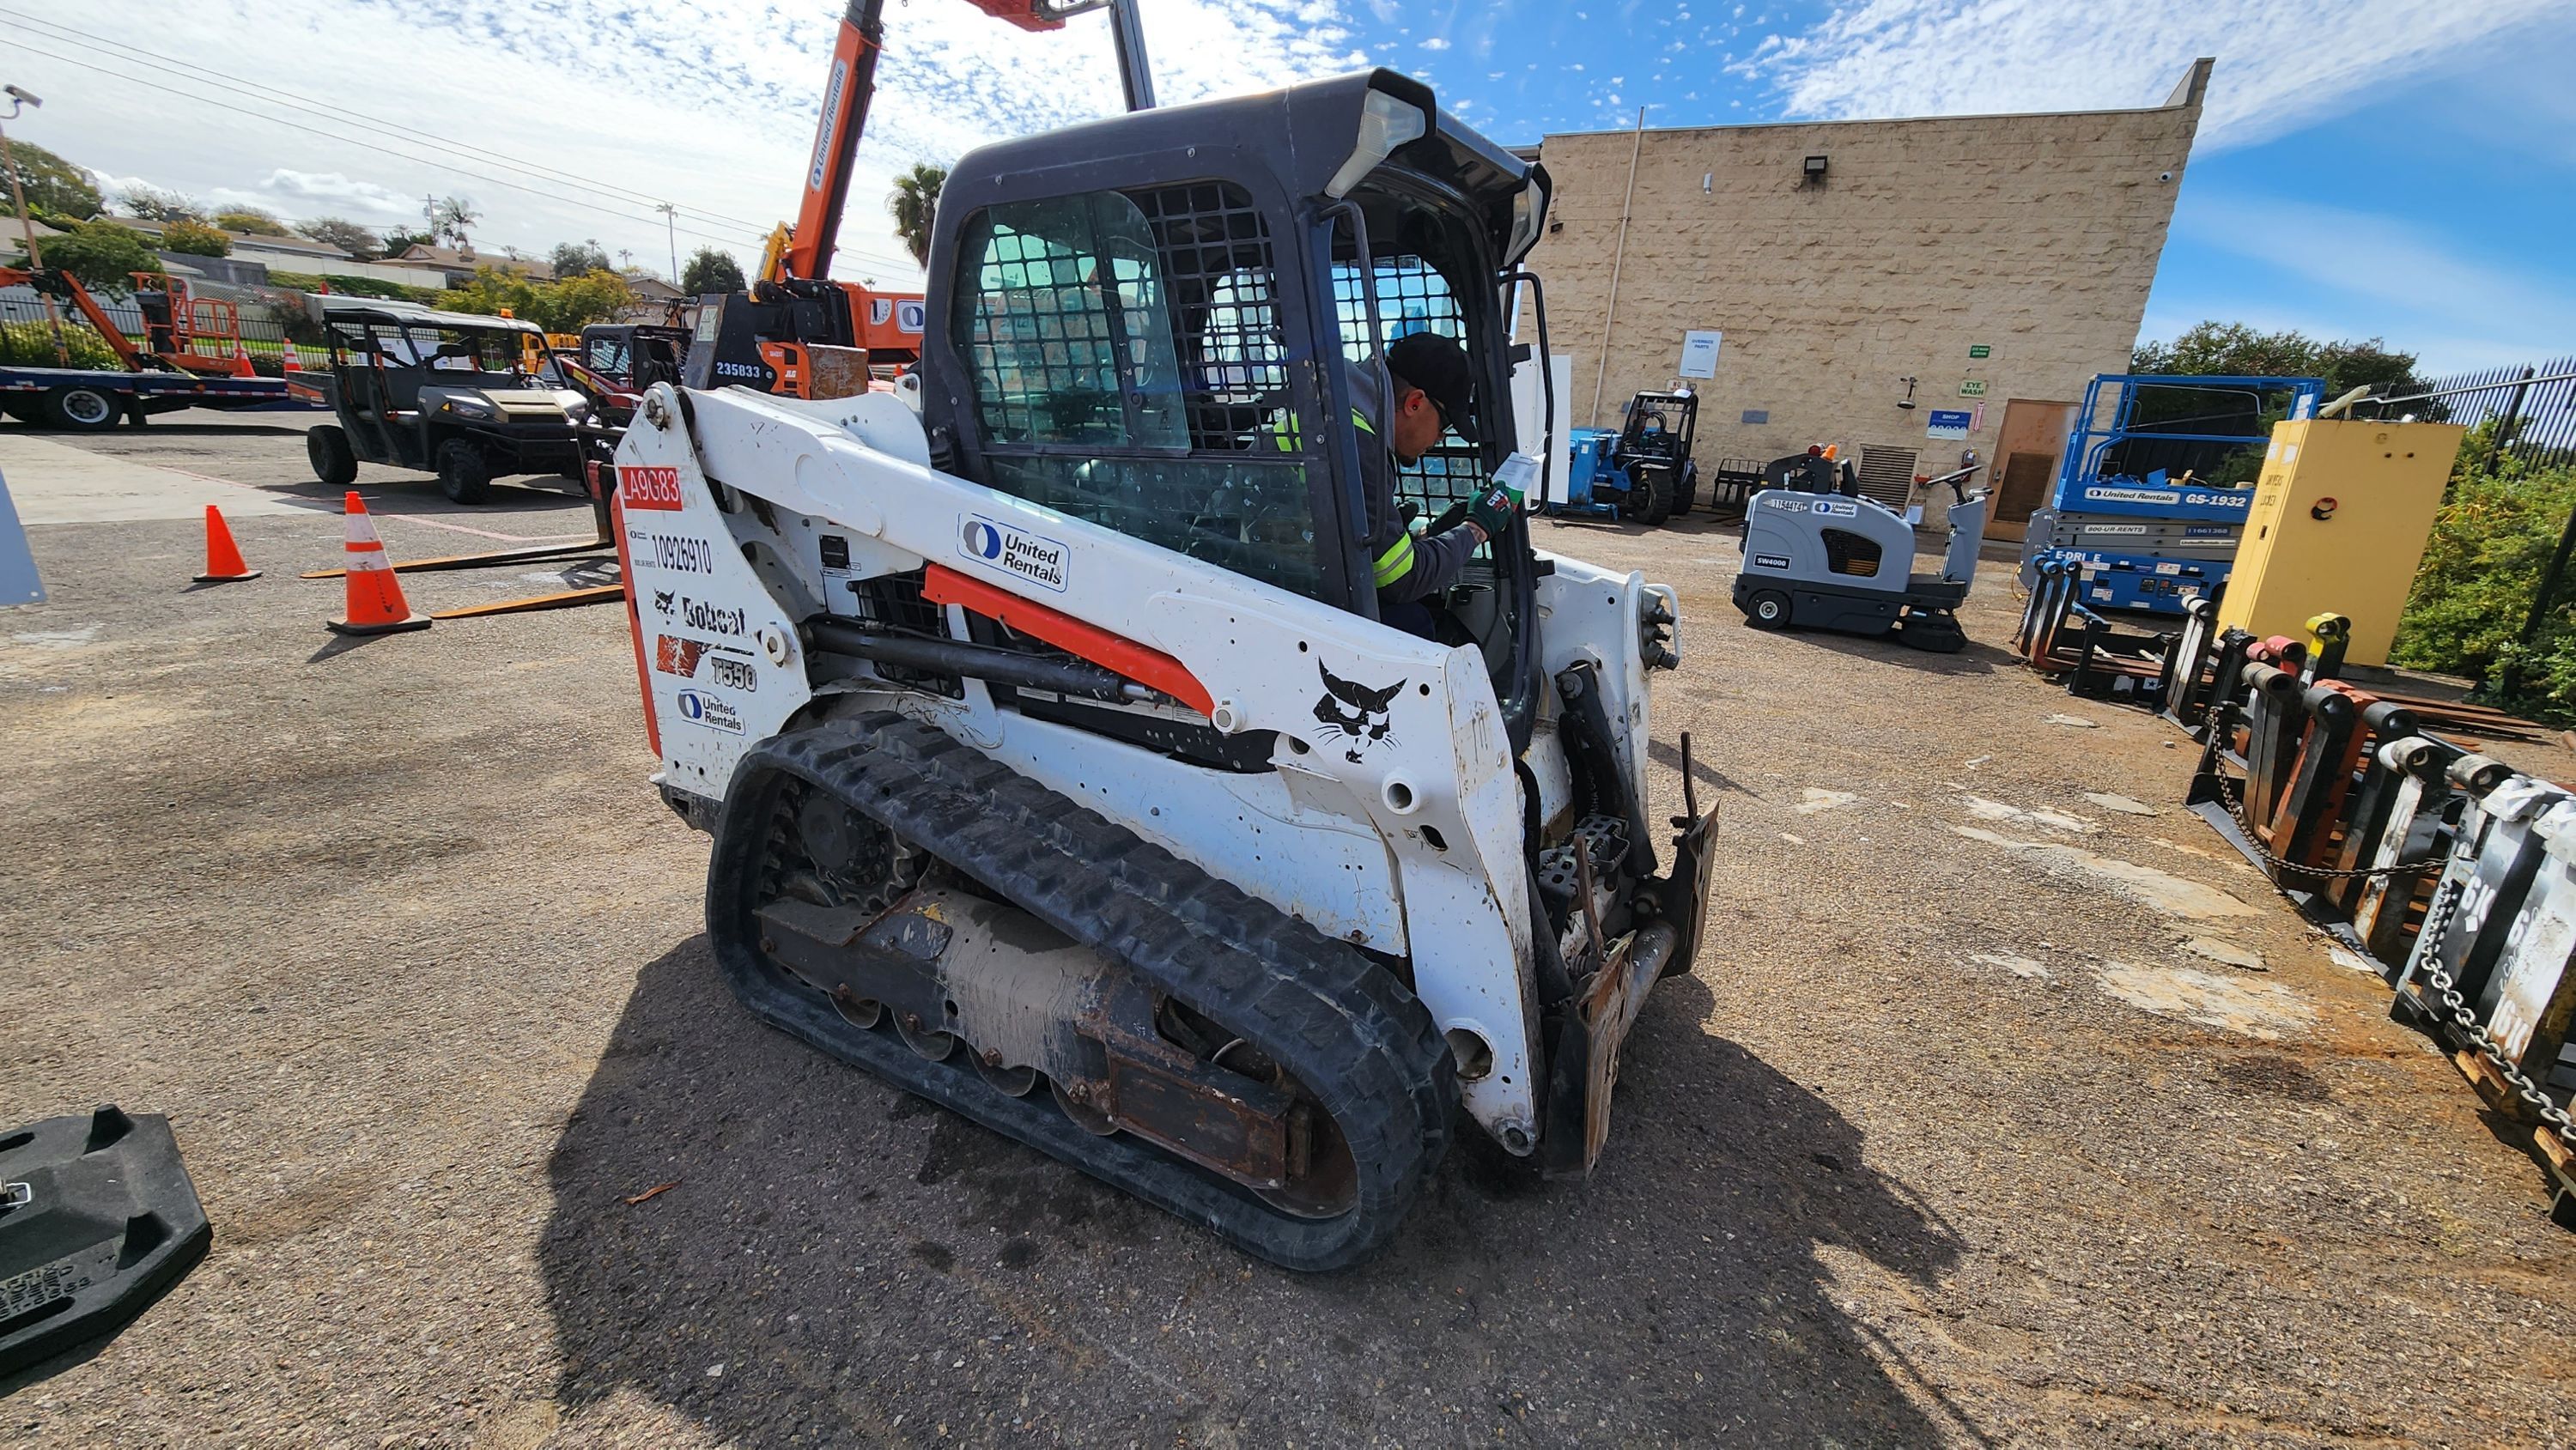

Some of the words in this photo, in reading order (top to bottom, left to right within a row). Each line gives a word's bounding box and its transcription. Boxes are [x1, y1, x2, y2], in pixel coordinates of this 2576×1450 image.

[817, 121, 832, 167] United
[827, 68, 845, 121] Rentals
[620, 470, 680, 501] LA9G83
[2103, 490, 2136, 500] United
[2137, 492, 2174, 501] Rentals
[2185, 494, 2247, 507] GS-1932
[652, 534, 712, 574] 10926910
[1005, 533, 1060, 566] United
[1757, 557, 1787, 567] SW4000
[1003, 551, 1062, 585] Rentals
[682, 597, 746, 636] Bobcat
[702, 696, 736, 716] United
[704, 711, 743, 731] Rentals
